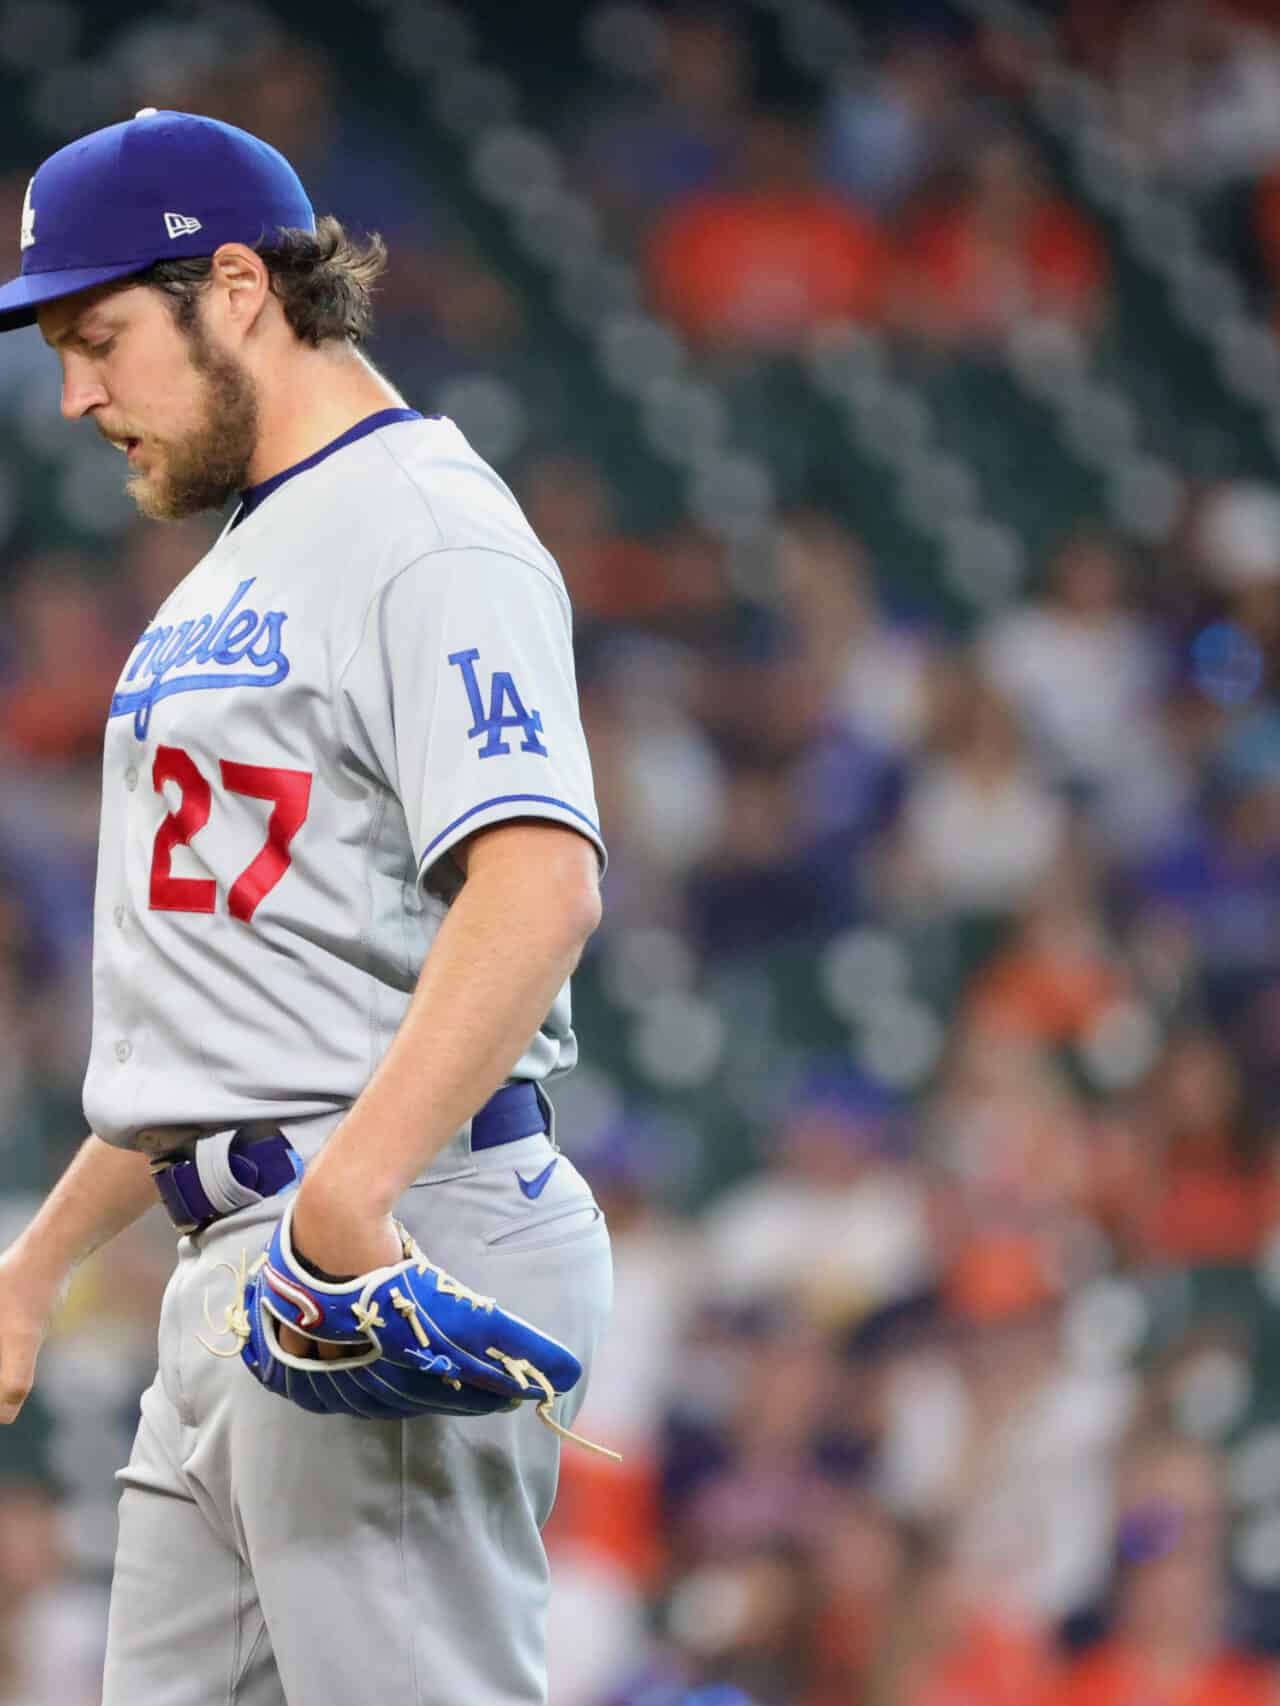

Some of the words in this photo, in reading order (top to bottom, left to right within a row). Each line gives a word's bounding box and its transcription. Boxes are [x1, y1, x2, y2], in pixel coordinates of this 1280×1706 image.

[120, 576, 290, 742] ngeles
[447, 647, 548, 760] LA
[149, 744, 313, 924] 27
